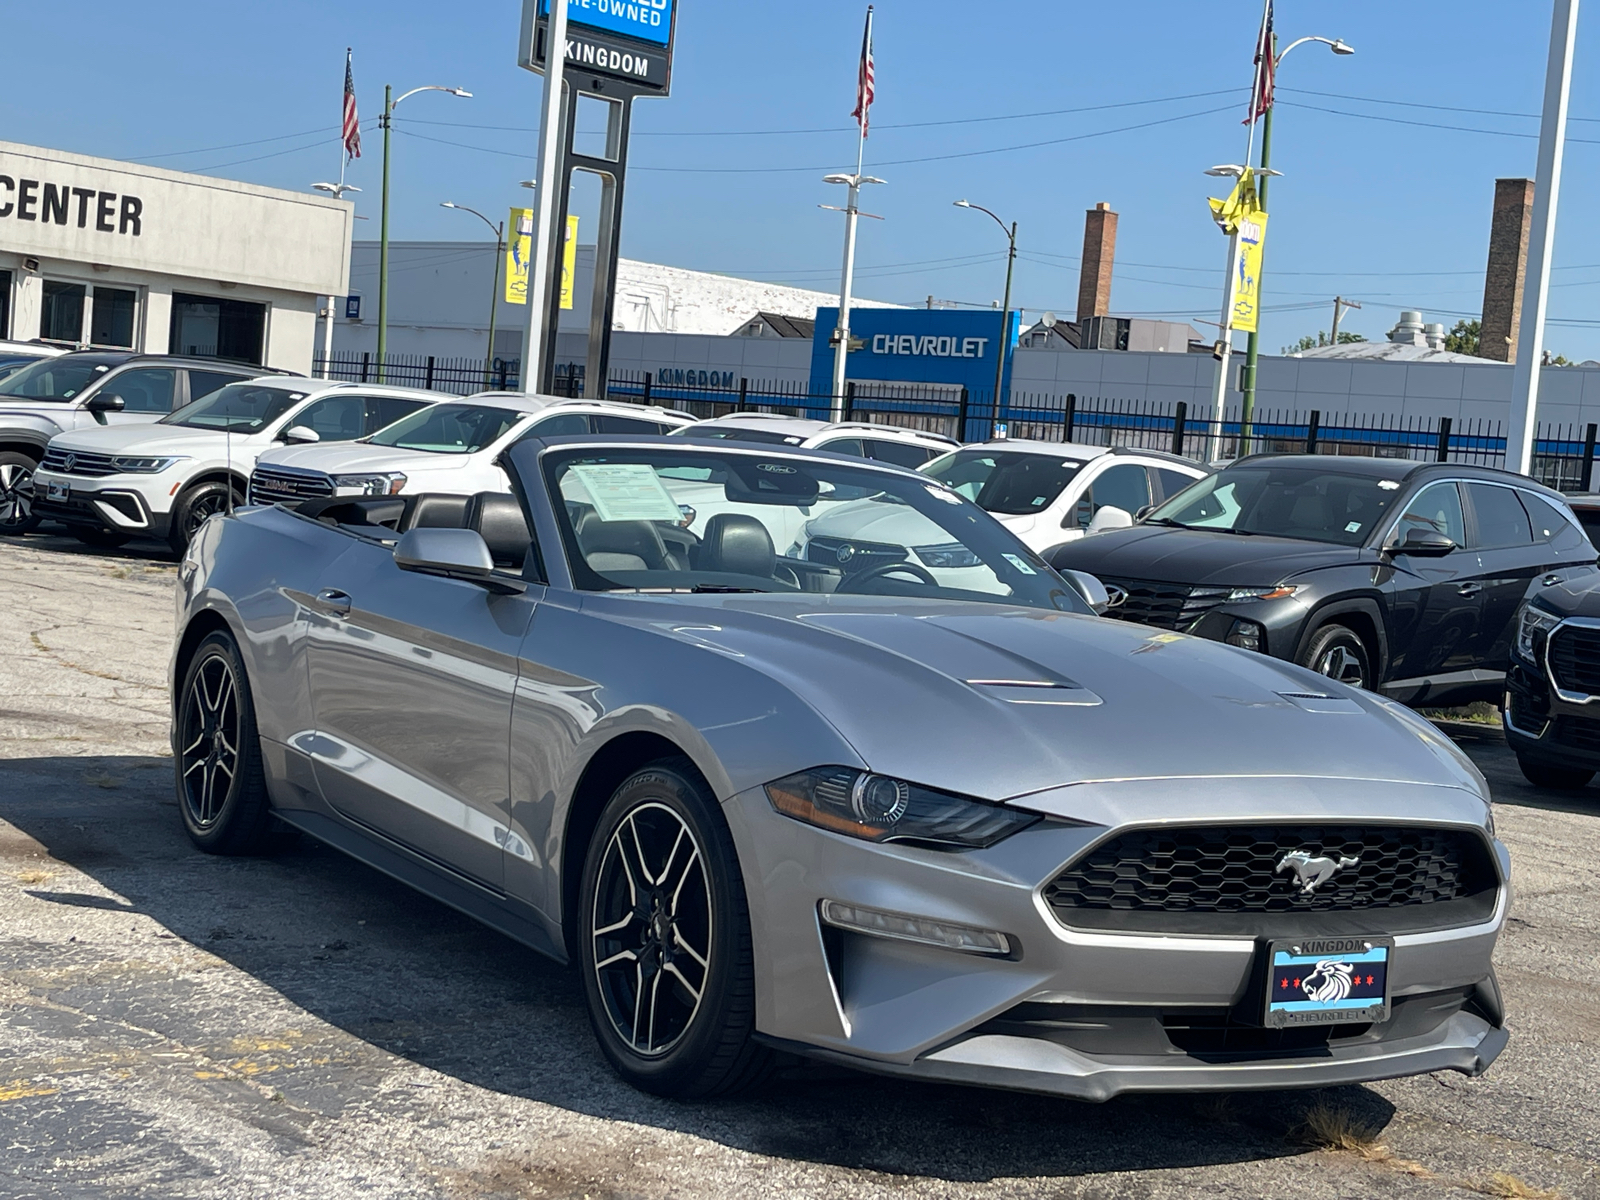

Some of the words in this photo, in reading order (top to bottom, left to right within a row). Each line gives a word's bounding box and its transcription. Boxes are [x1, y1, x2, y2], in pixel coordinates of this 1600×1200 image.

[564, 39, 648, 77] KINGDOM
[0, 174, 143, 236] CENTER
[872, 334, 989, 358] CHEVROLET
[658, 368, 734, 387] KINGDOM
[1301, 940, 1365, 953] KINGDOM
[1294, 1010, 1361, 1023] CHEVROLET
